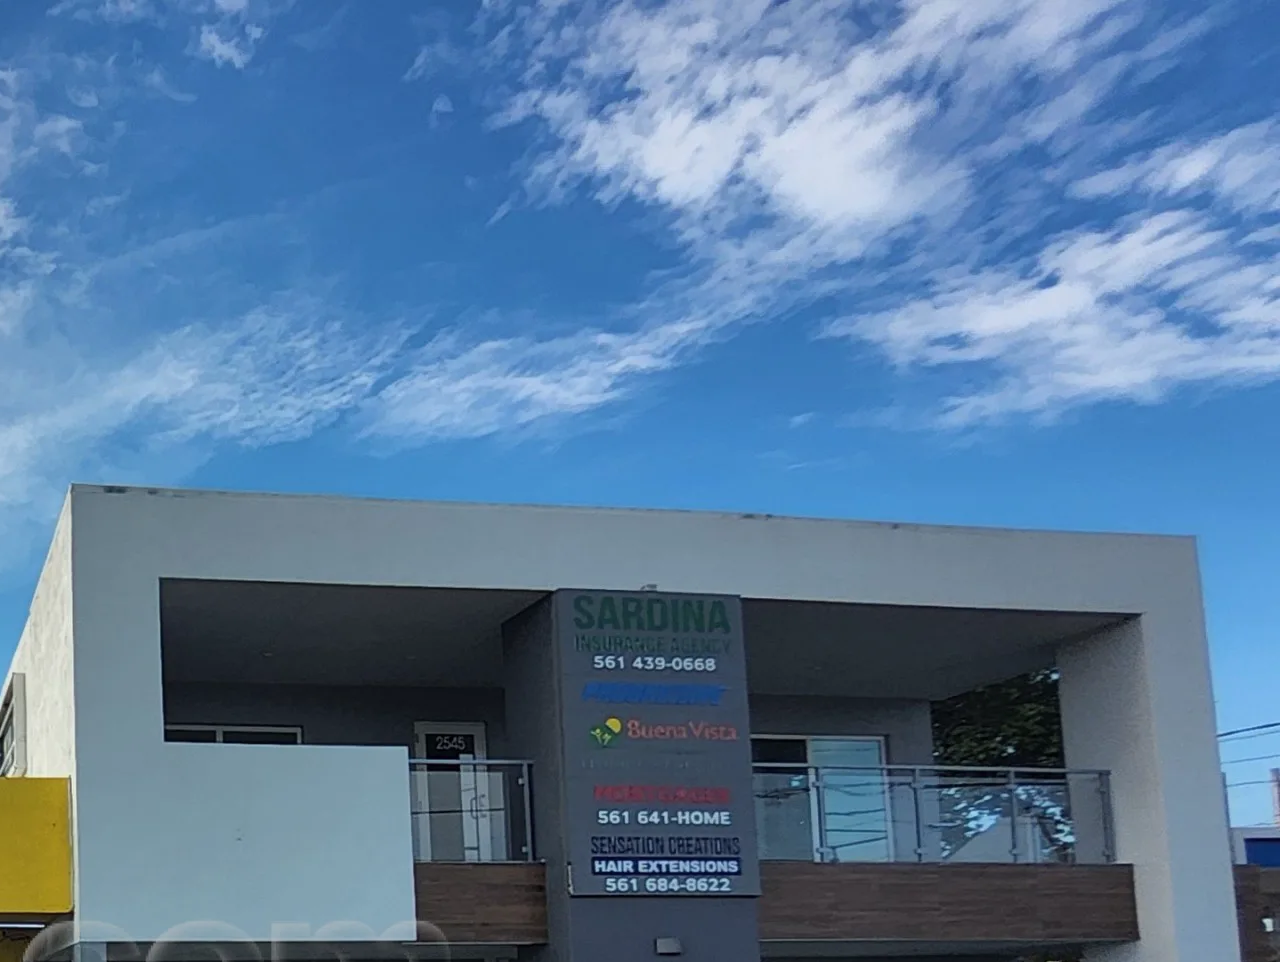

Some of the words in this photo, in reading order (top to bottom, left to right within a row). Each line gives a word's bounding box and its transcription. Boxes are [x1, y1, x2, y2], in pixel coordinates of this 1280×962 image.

[573, 594, 731, 634] SARDINA
[574, 633, 666, 653] INSURANCE
[670, 637, 732, 654] AGENCY
[593, 655, 625, 669] 561
[632, 656, 717, 672] 439-0668
[626, 719, 687, 739] Buena
[687, 720, 739, 741] Vista
[436, 736, 466, 750] 2545
[598, 810, 630, 824] 561
[637, 811, 732, 825] 641-HOME
[591, 836, 665, 855] SENSATION
[668, 836, 740, 855] CREATIONS
[594, 860, 634, 873] HAIR
[638, 860, 738, 873] EXTENSIONS
[606, 878, 638, 891] 561
[645, 878, 732, 892] 684-8622
